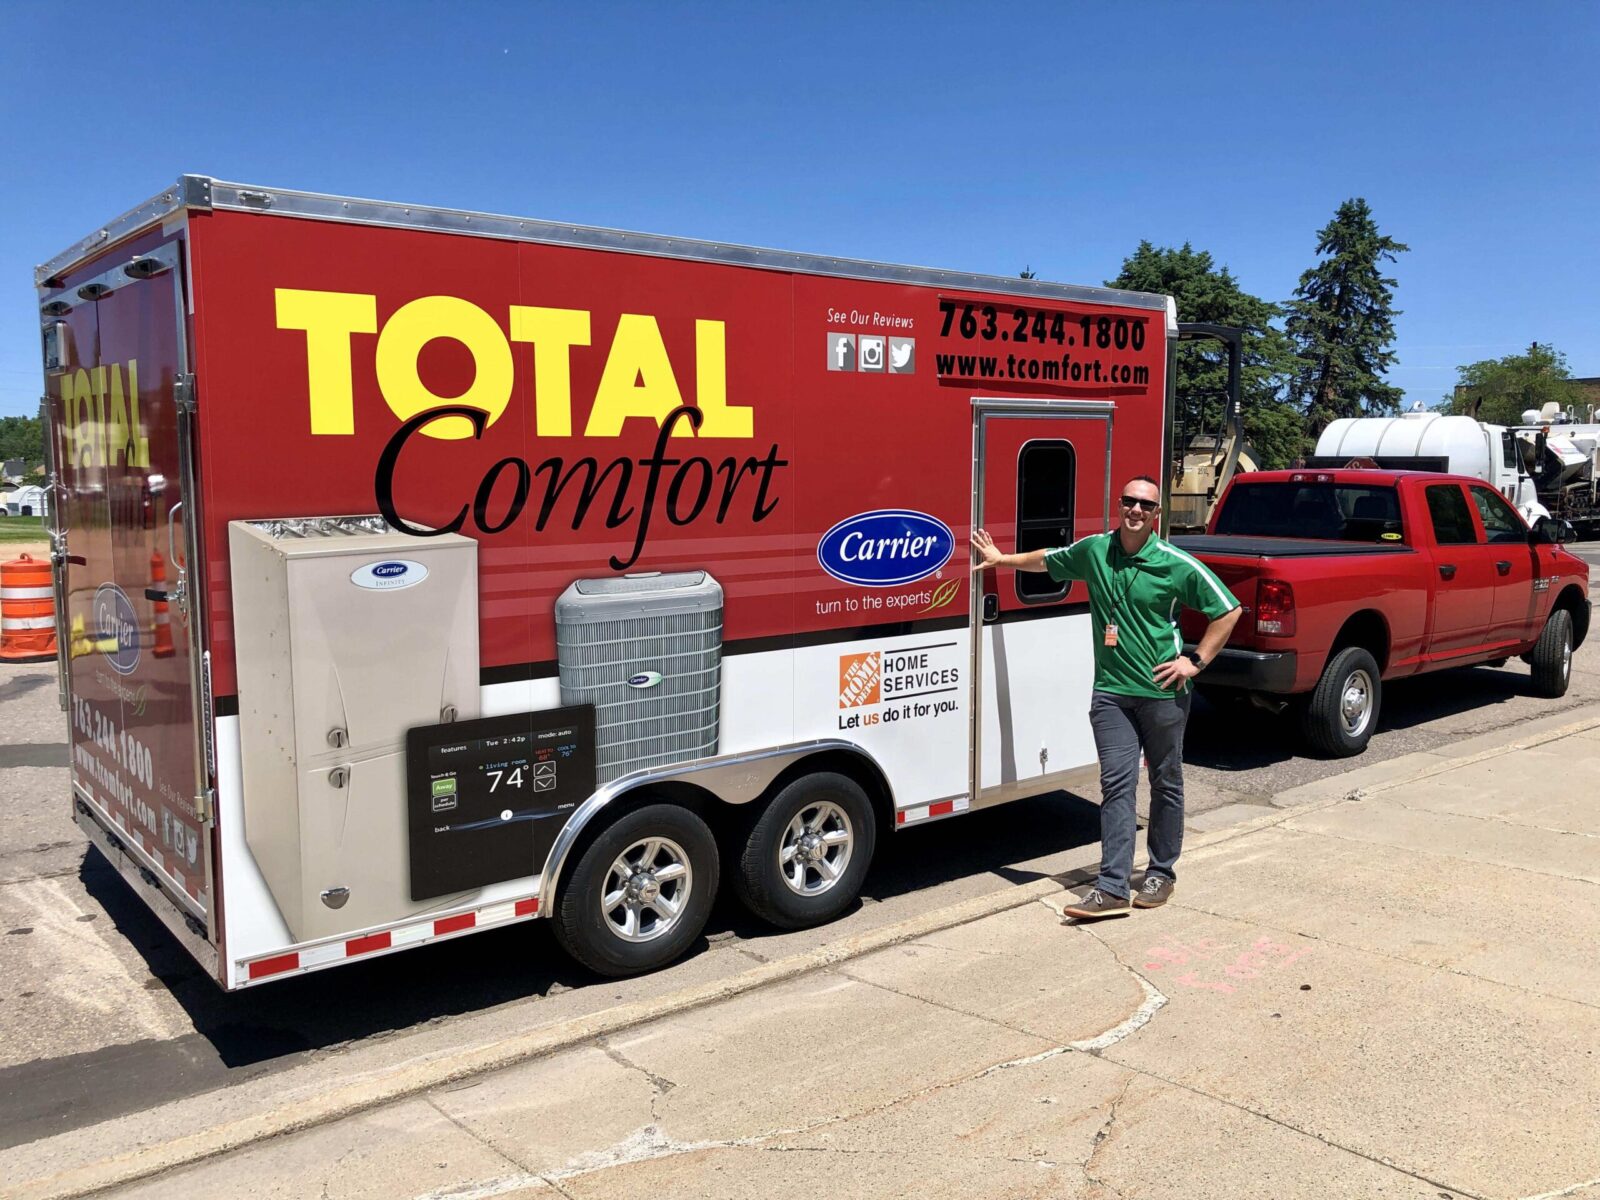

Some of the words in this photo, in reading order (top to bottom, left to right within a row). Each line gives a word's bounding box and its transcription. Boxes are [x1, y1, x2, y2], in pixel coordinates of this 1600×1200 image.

[827, 308, 847, 324] See
[850, 310, 870, 326] Our
[873, 313, 914, 329] Reviews
[939, 302, 1146, 351] 763.244.1800
[275, 287, 754, 440] TOTAL
[936, 354, 1149, 385] www.tcomfort.com
[60, 359, 150, 468] TOTAL
[375, 405, 789, 571] Comfort
[840, 531, 937, 562] Carrier
[376, 566, 404, 575] Carrier
[816, 600, 842, 614] turn
[845, 597, 859, 611] to
[862, 595, 883, 609] the
[100, 603, 134, 648] Carrier
[844, 660, 862, 683] THE
[884, 654, 929, 674] HOME
[840, 652, 881, 709] HOME
[883, 668, 959, 693] SERVICES
[838, 713, 860, 730] Let
[863, 713, 880, 726] us
[883, 708, 900, 723] do
[903, 705, 911, 719] it
[914, 703, 931, 717] for
[933, 700, 959, 718] you.
[441, 744, 467, 754] features
[486, 739, 499, 747] Tue
[503, 736, 526, 745] 2:42p
[486, 761, 509, 770] living
[511, 758, 527, 766] room
[558, 802, 575, 810] menu
[434, 825, 450, 833] back
